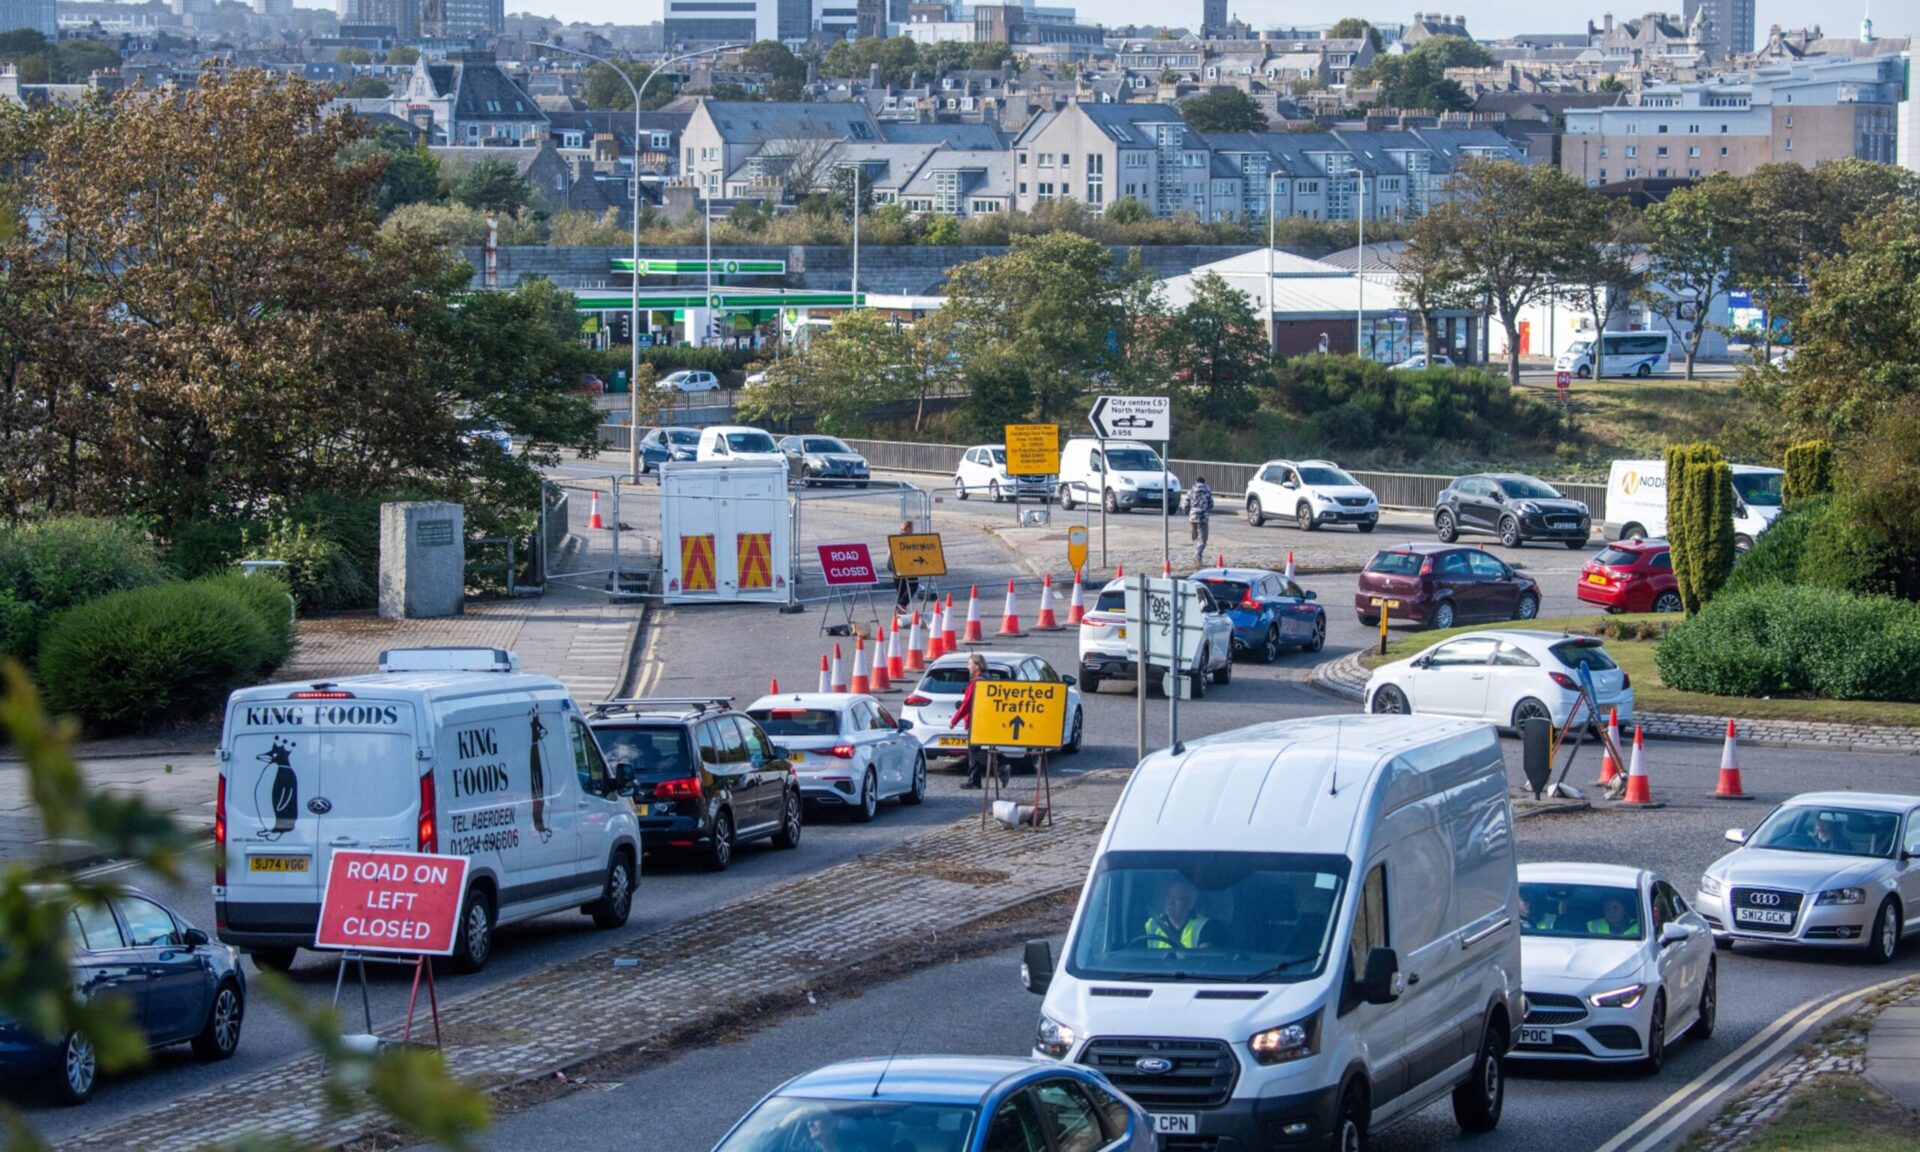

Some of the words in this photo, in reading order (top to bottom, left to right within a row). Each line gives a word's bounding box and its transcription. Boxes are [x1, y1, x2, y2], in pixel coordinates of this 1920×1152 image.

[1152, 399, 1168, 407] (S)
[1135, 407, 1164, 415] Harbour
[1111, 429, 1132, 437] A956
[899, 541, 937, 553] Diversion
[831, 551, 859, 562] ROAD
[830, 566, 869, 577] CLOSED
[986, 684, 1055, 700] Diverted
[993, 699, 1046, 714] Traffic
[246, 706, 303, 726] KING
[314, 706, 398, 725] FOODS
[457, 727, 498, 760] KING
[453, 762, 509, 798] FOODS
[471, 807, 516, 830] ABERDEEN
[450, 835, 481, 856] 01224
[255, 858, 281, 870] SJ74
[284, 858, 304, 870] VGG
[347, 861, 409, 882] ROAD
[414, 865, 448, 884] ON
[367, 890, 418, 910] LEFT
[1742, 909, 1763, 921] SM12
[1766, 911, 1786, 922] GCK
[343, 916, 431, 940] CLOSED
[1521, 1030, 1547, 1041] POC
[1160, 1116, 1189, 1131] CPN
